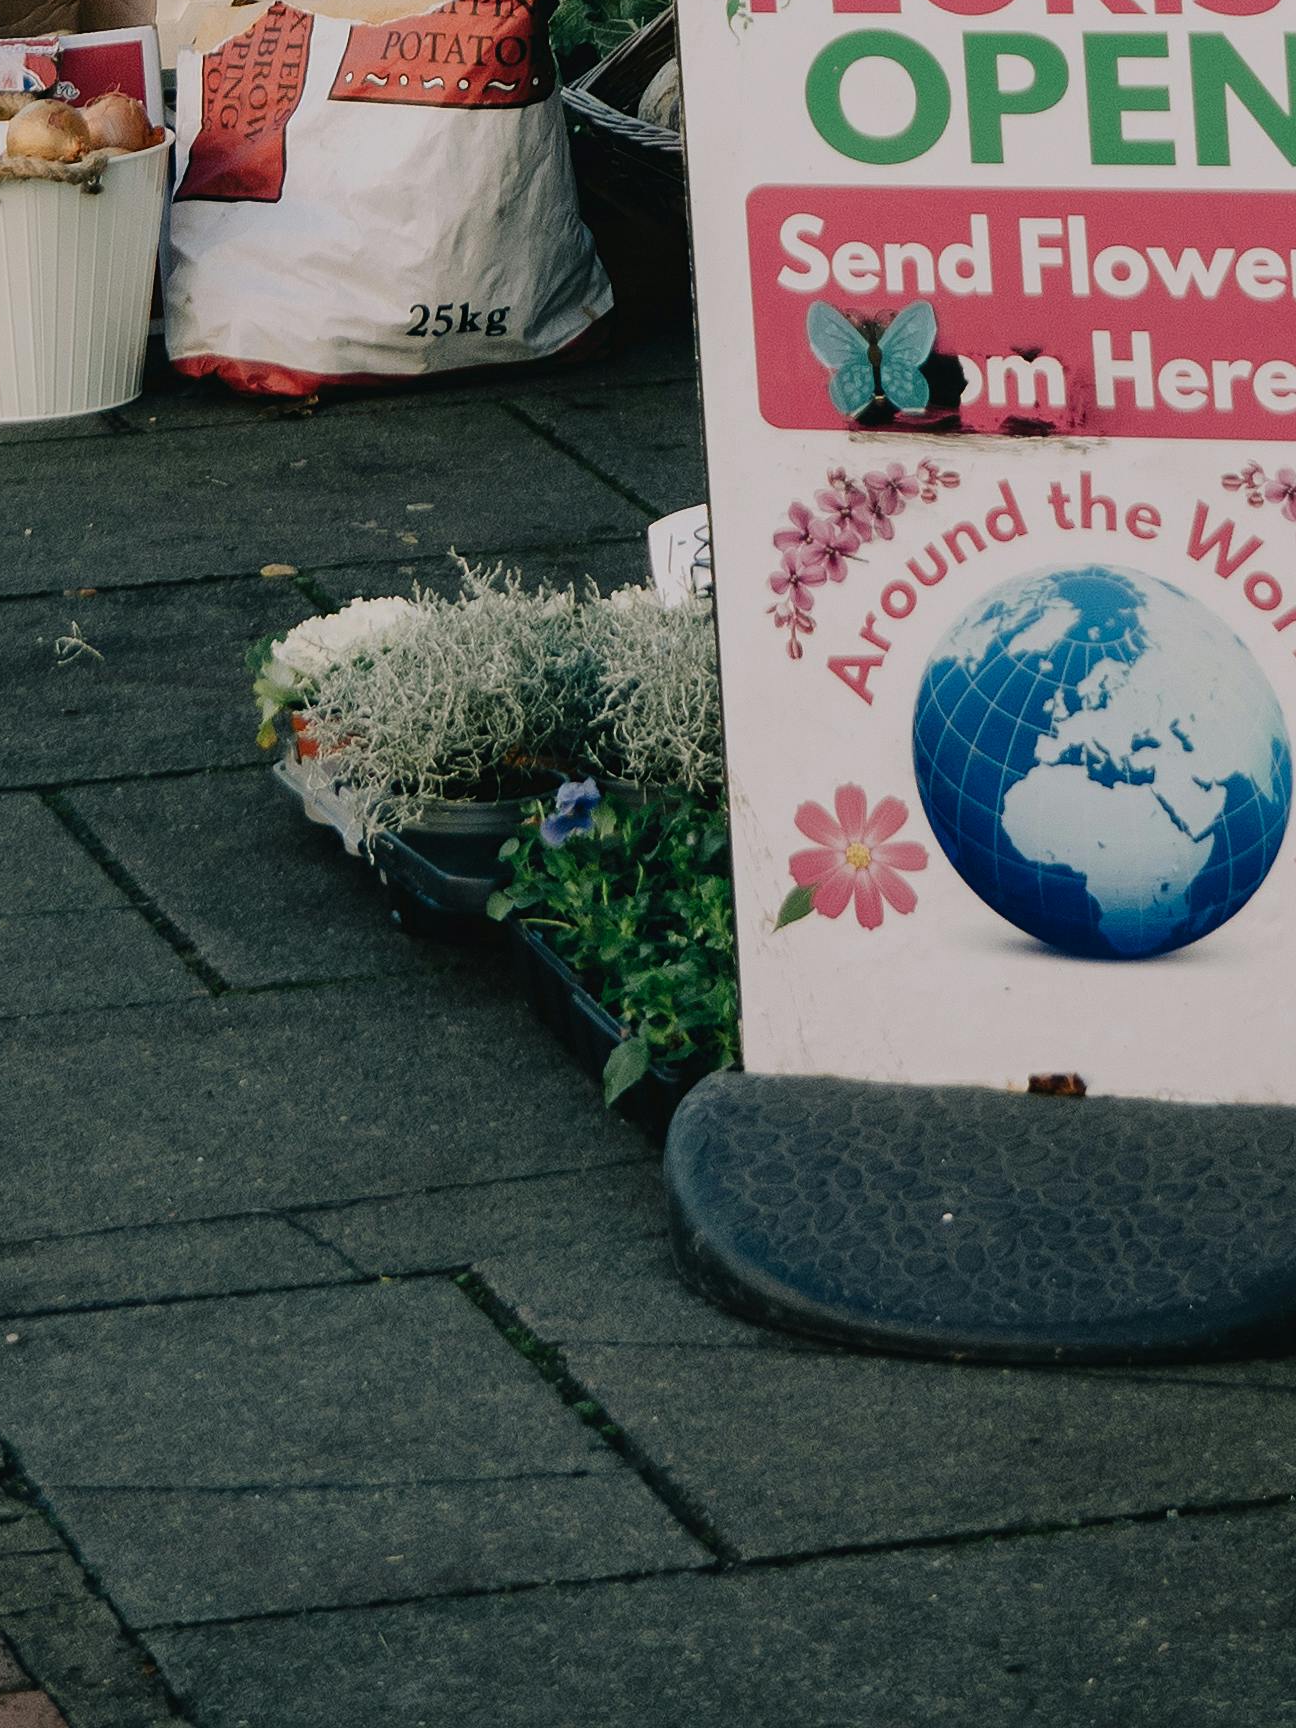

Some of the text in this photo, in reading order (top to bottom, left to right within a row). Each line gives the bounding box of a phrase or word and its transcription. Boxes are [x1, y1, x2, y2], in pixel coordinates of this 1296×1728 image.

[380, 29, 529, 68] POTATO
[777, 212, 994, 295] Send
[406, 302, 512, 339] 25kg
[825, 477, 1032, 707] Around
[1045, 469, 1163, 542] the
